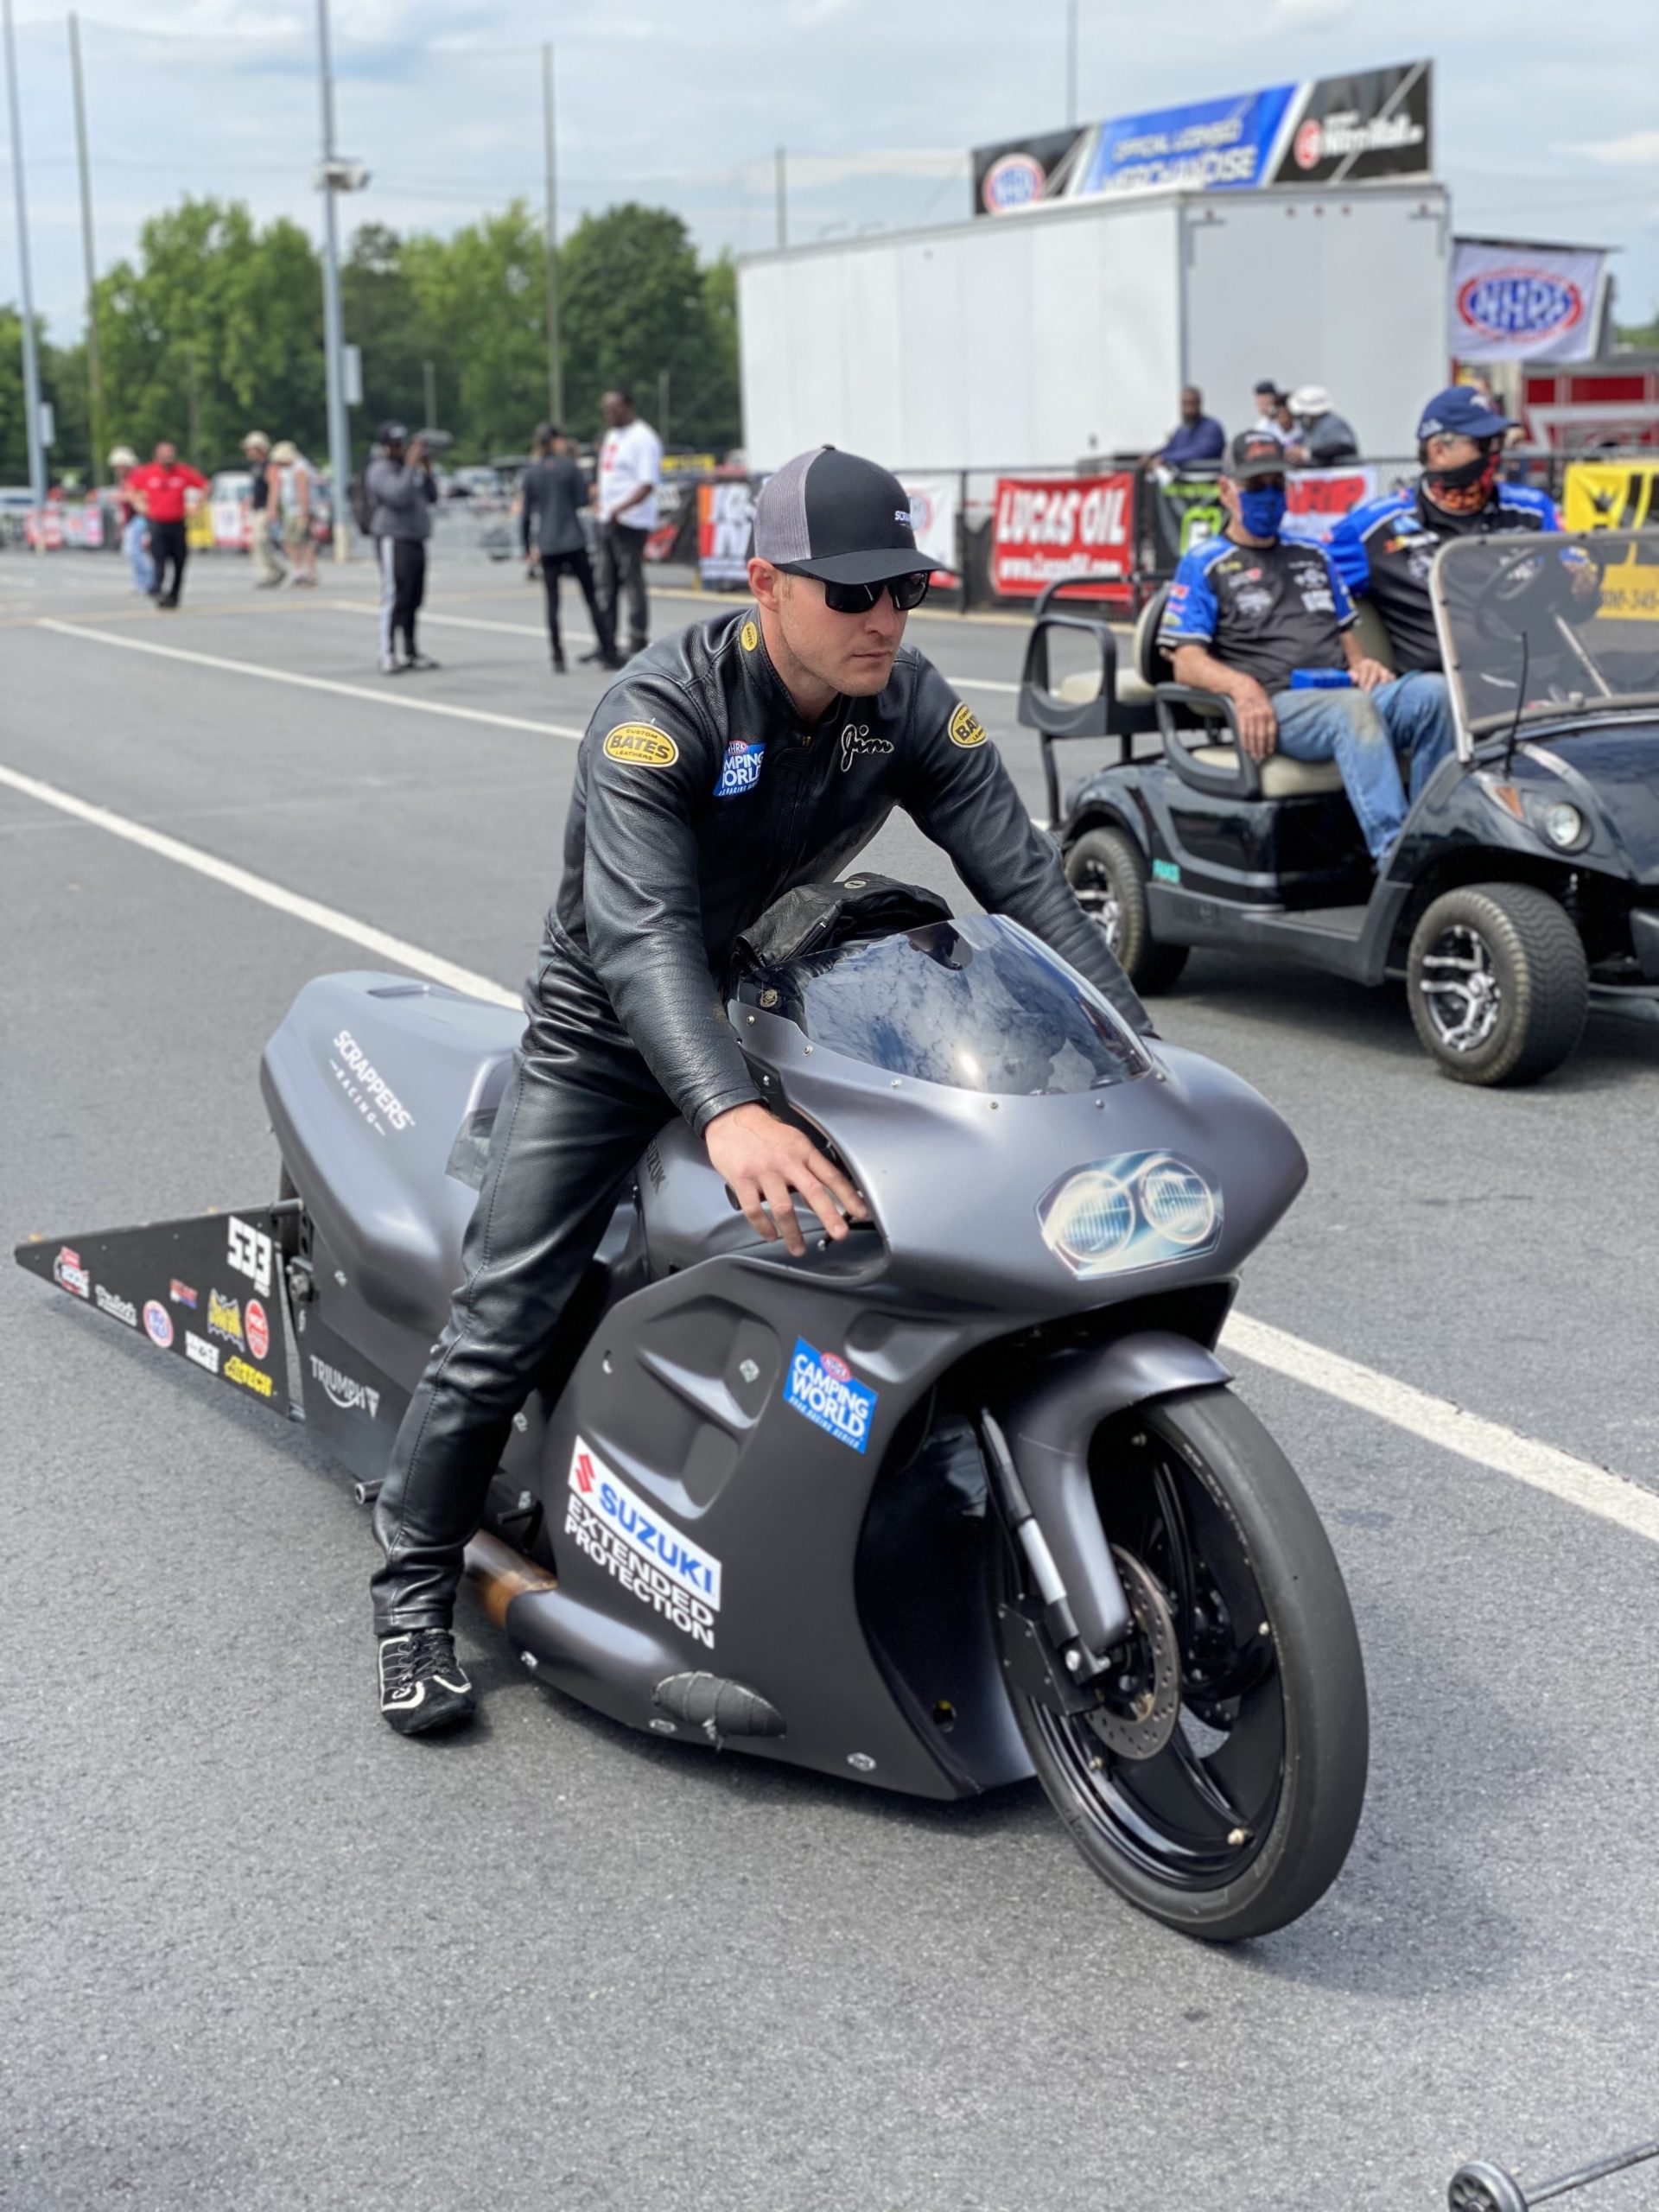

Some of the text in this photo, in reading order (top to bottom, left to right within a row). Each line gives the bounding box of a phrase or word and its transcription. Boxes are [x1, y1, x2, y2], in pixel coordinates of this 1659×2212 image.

[1471, 277, 1571, 332] NHRA
[997, 487, 1127, 546] LUCAS OIL
[609, 734, 671, 760] BATES
[615, 749, 653, 761] LEATHERS
[626, 728, 658, 747] CUSTOM
[723, 750, 765, 772] MPING
[333, 1029, 407, 1130] SCRAPPERS
[335, 1068, 378, 1124] RACING
[226, 1215, 272, 1287] 533
[309, 1354, 366, 1410] TRIUMPH
[792, 1369, 866, 1438] WORLD
[794, 1353, 870, 1420] CAMPING
[568, 1491, 715, 1628] EXTENDED
[600, 1482, 714, 1595] SUZUKI
[563, 1512, 716, 1650] PROTECTION
